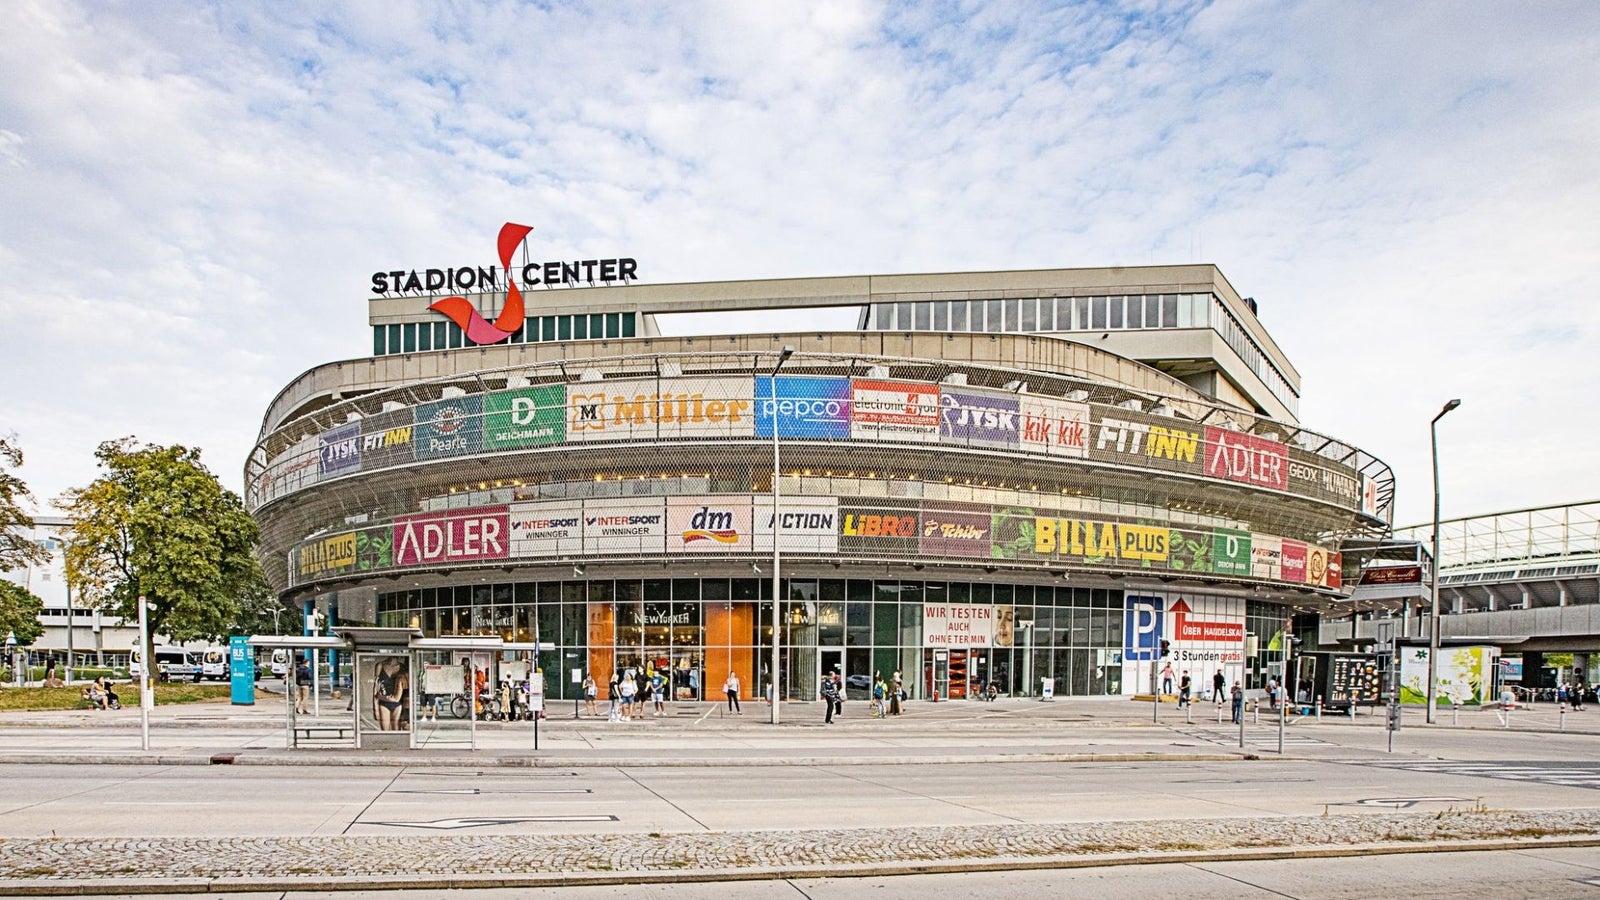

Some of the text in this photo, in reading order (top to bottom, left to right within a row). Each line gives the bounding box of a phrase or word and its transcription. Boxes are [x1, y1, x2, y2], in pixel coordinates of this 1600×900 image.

[371, 257, 637, 294] STADION CENTER
[512, 396, 536, 425] D
[580, 404, 597, 420] M
[612, 393, 748, 426] Müller
[762, 398, 841, 418] pepco
[956, 406, 1017, 431] JYSK
[495, 428, 554, 441] DEICHMANN
[327, 438, 358, 462] JYSK
[430, 436, 467, 452] Pearle
[1210, 433, 1281, 485] ADLER
[1289, 463, 1317, 482] GEOX
[522, 518, 579, 530] INTERSPORT
[598, 515, 661, 526] INTERSPORT
[691, 507, 733, 530] dm
[526, 530, 568, 539] WINNINGER
[602, 527, 649, 536] WINNINGER
[940, 523, 987, 540] Tchibo
[1035, 516, 1164, 558] BILLA PLUS
[397, 518, 502, 564] ADLER
[1226, 535, 1239, 558] D
[329, 540, 353, 561] PLUS
[926, 607, 990, 619] WIR TESTEN
[948, 622, 969, 632] AUCH
[1132, 603, 1156, 653] P
[1182, 625, 1201, 636] ÜBER
[929, 634, 985, 644] OHNE TERMIN
[232, 648, 244, 657] BUS
[1173, 651, 1179, 661] 3
[1182, 650, 1219, 661] Stunden
